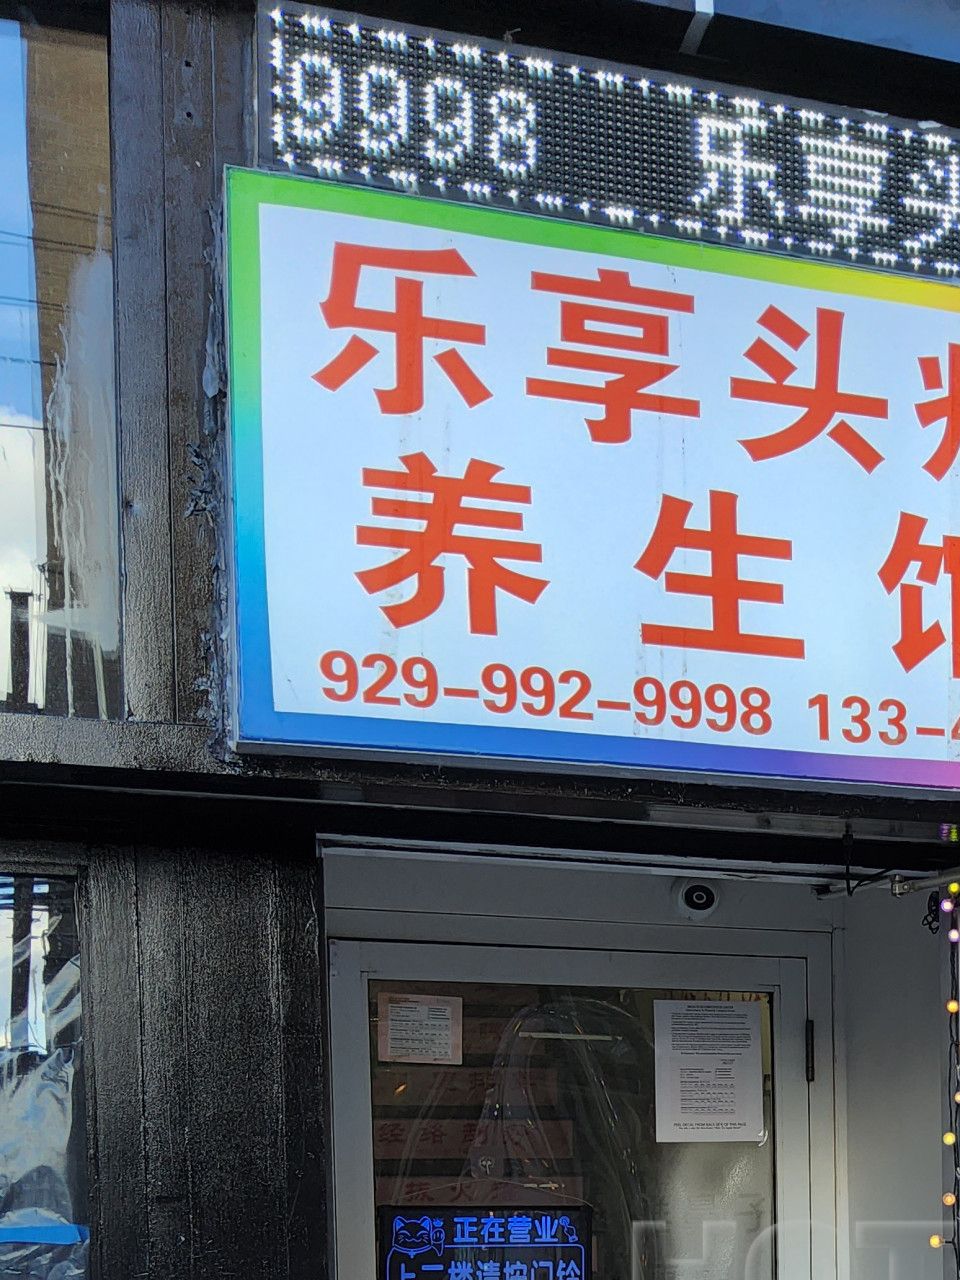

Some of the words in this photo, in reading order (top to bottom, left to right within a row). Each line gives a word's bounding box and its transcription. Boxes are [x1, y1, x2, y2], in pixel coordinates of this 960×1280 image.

[294, 52, 538, 175] 9998
[319, 651, 773, 737] 929-992-9998
[452, 1216, 560, 1244] 正在营业
